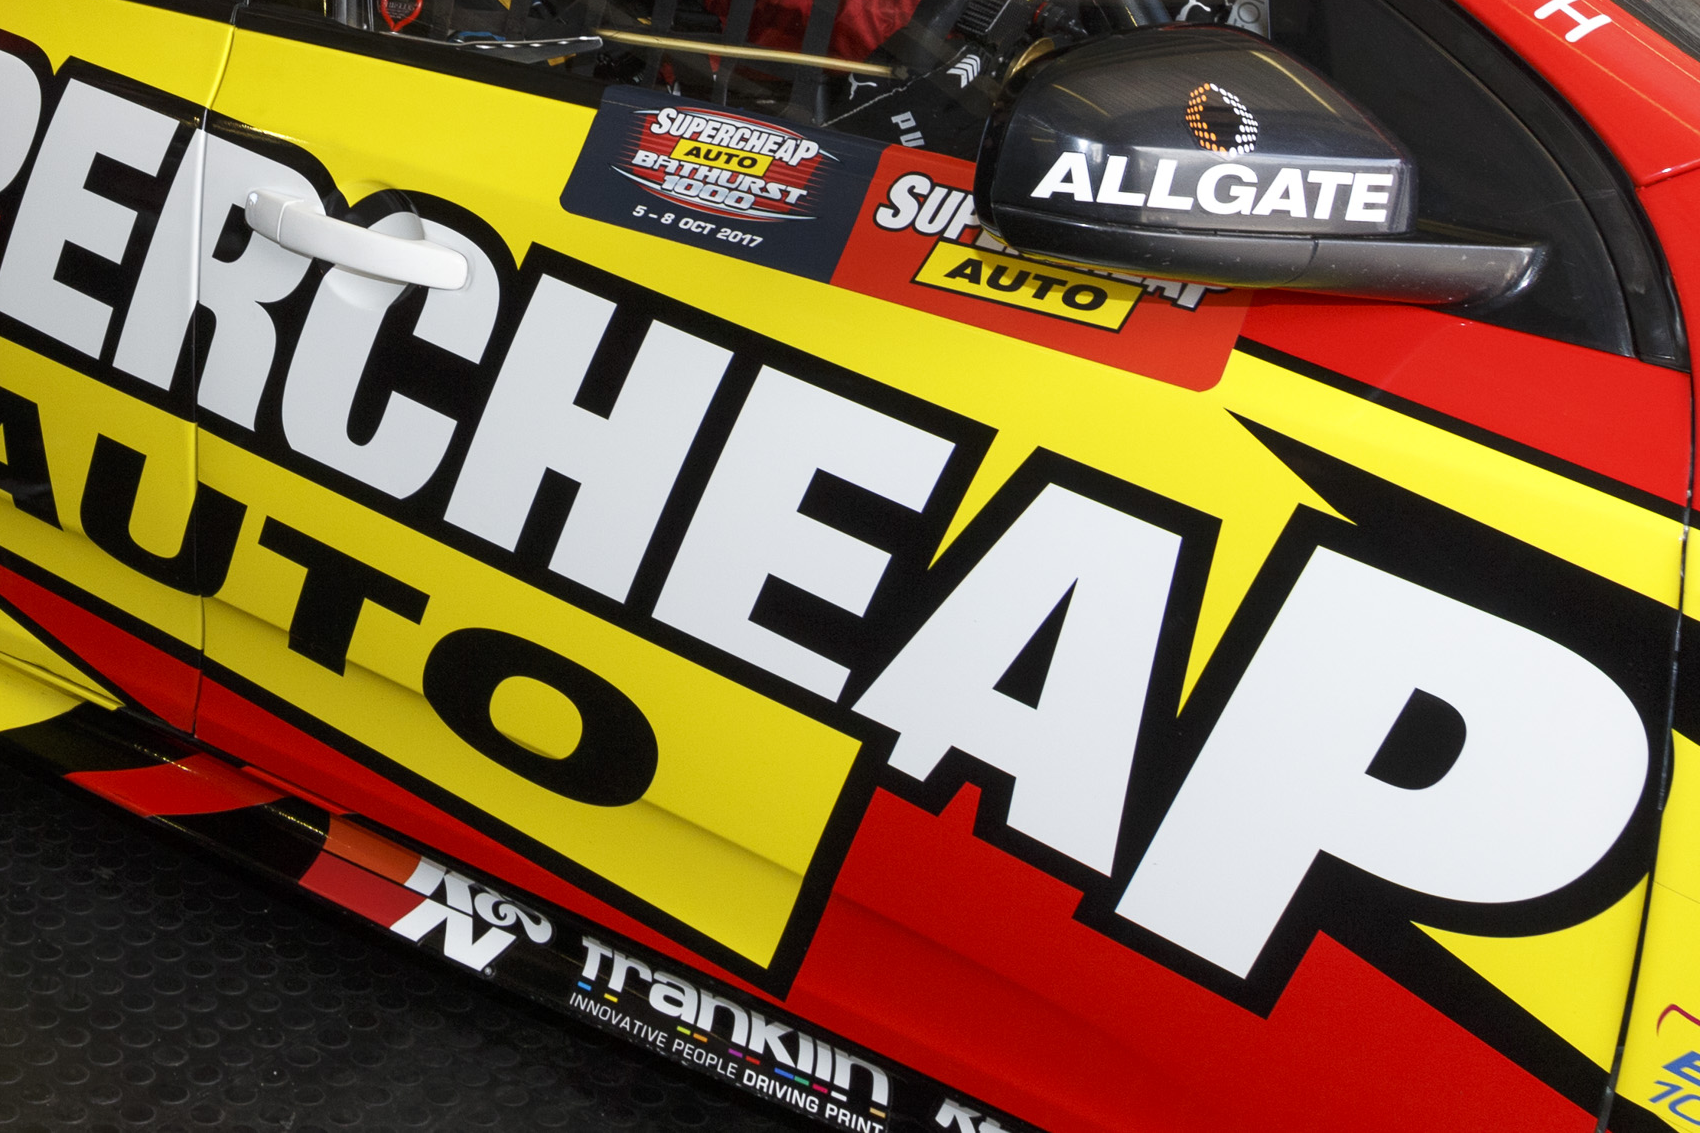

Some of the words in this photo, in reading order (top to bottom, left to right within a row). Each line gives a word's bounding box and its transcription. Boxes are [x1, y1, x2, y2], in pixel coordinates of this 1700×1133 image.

[649, 106, 820, 167] SUPERCHEAP
[683, 145, 758, 169] AUTO
[631, 149, 808, 205] BATHURST
[660, 174, 756, 210] 1000
[1030, 151, 1396, 223] ALLGATE
[678, 217, 716, 235] OCT
[716, 226, 764, 247] 2017
[944, 257, 1109, 312] AUTO
[569, 992, 668, 1047] INNOVATIVE
[671, 1039, 738, 1079] PEOPLE
[742, 1068, 819, 1114] DRIVING
[824, 1103, 885, 1133] PRINT
